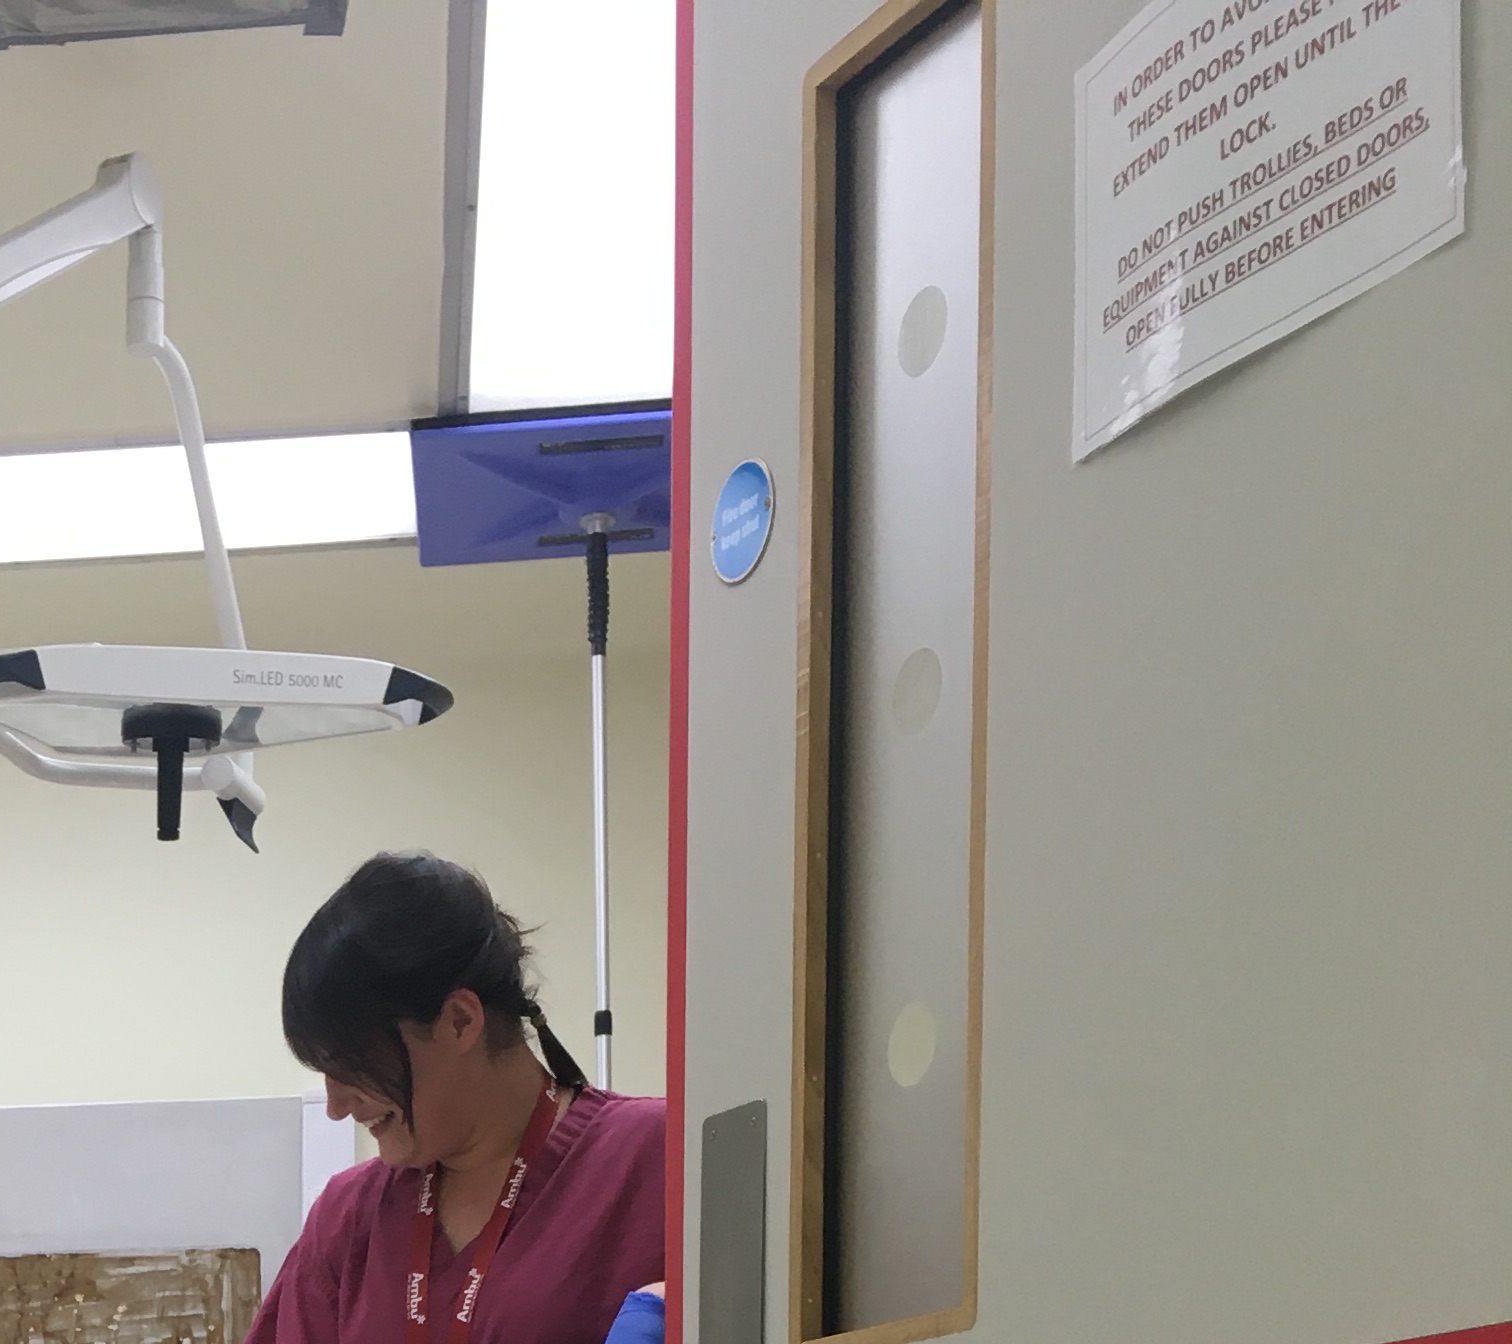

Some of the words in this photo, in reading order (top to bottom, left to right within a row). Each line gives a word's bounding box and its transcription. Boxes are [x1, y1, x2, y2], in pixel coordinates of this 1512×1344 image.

[1113, 86, 1128, 118] IN
[1131, 39, 1185, 98] ORDER
[1189, 18, 1215, 52] TO
[1113, 135, 1170, 198] EXTEND
[1173, 94, 1228, 147] THEM
[1233, 56, 1289, 108] OPEN
[1295, 16, 1357, 70] UNTIL
[1127, 88, 1174, 142] THESE
[1178, 40, 1245, 104] DOORS
[1250, 0, 1323, 56] PLEASE
[1118, 247, 1138, 279] DO
[1142, 218, 1173, 259] NOT
[1177, 188, 1224, 234] PUSH
[1229, 133, 1318, 201] TROLLIES,
[1324, 97, 1374, 144] BEDS
[1379, 76, 1408, 111] OR
[1220, 111, 1276, 161] LOCK.
[1103, 248, 1189, 328] EQUIPMENT
[1193, 198, 1274, 263] AGAINST
[1278, 154, 1351, 212] CLOSED
[1357, 106, 1430, 167] DOORS,
[1126, 305, 1166, 347] OPEN
[1170, 269, 1219, 316] FULLY
[1224, 226, 1294, 285] BEFORE
[1299, 166, 1396, 243] ENTERING
[232, 668, 284, 686] Sim.LED
[288, 673, 320, 688] 5000
[323, 674, 344, 689] MC
[500, 1163, 528, 1209] Ambu
[410, 1272, 425, 1320] Ambu
[456, 1273, 481, 1323] Ambu
